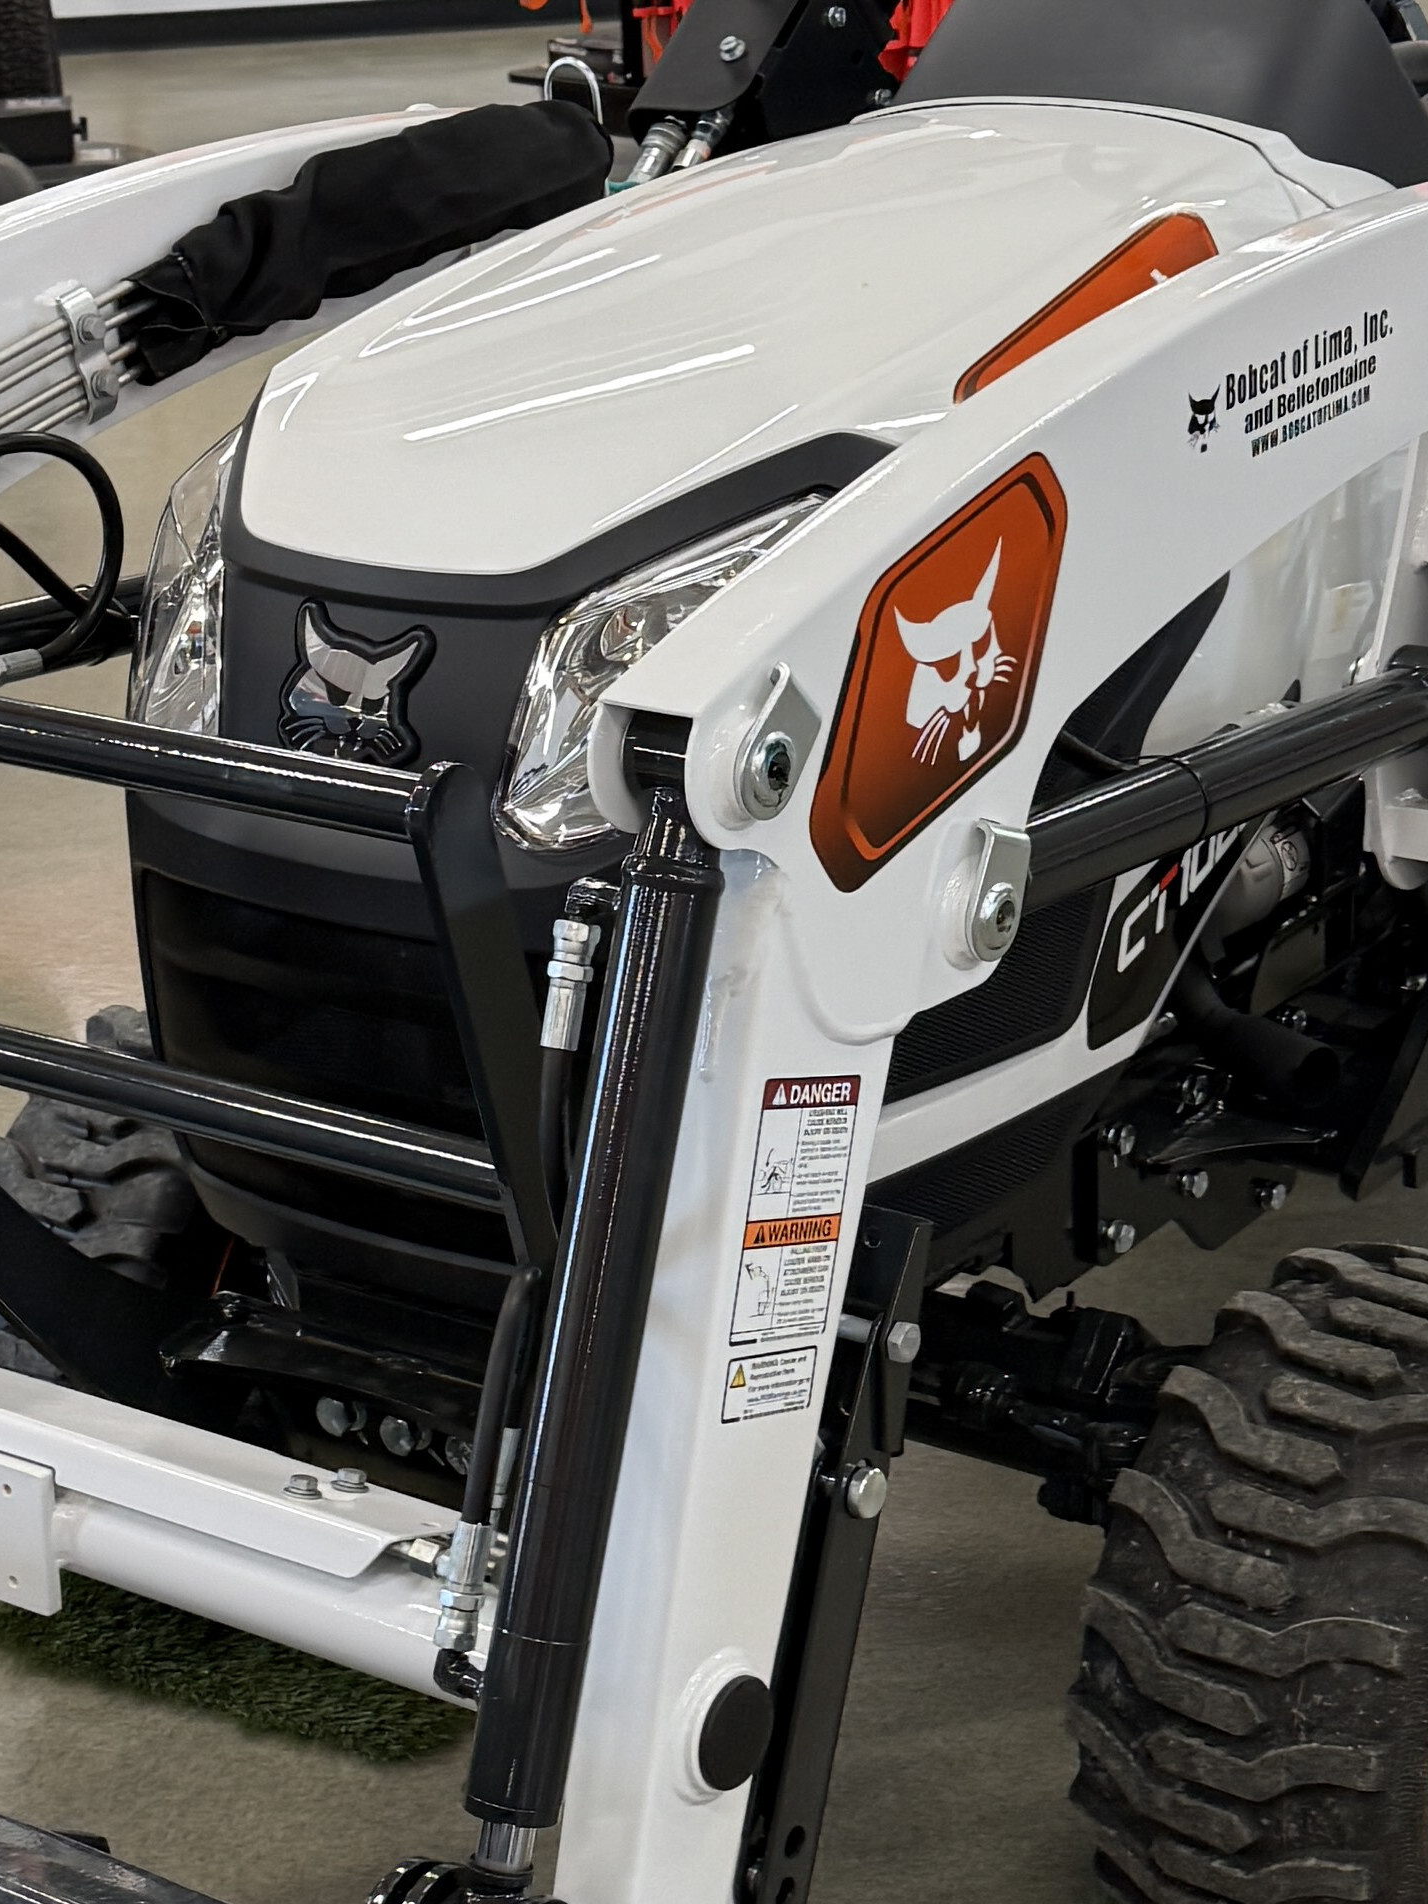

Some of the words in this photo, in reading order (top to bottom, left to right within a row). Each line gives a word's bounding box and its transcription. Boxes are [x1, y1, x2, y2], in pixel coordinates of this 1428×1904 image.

[1225, 351, 1287, 411] Bobcat
[1292, 338, 1309, 379] of
[1314, 324, 1358, 371] Lima,
[1363, 308, 1394, 347] Inc.
[1244, 398, 1273, 434] and
[1277, 354, 1377, 419] Bellefontaine
[790, 1082, 852, 1105] DANGER
[767, 1219, 832, 1242] WARNING
